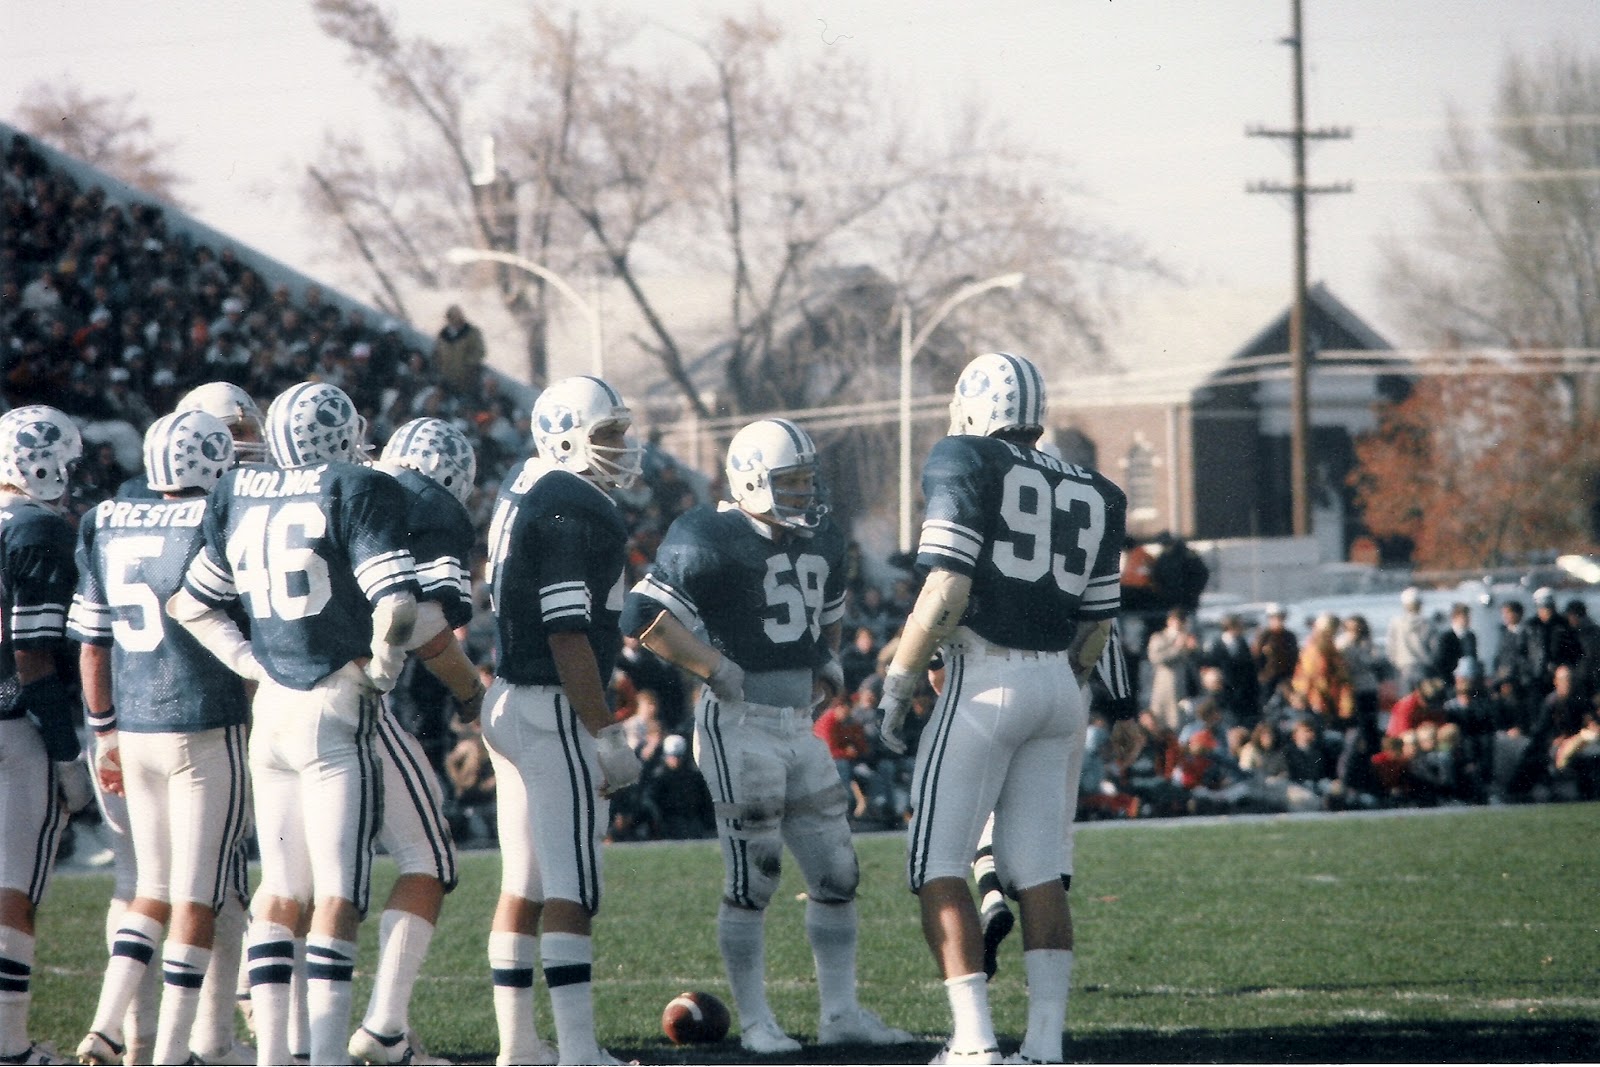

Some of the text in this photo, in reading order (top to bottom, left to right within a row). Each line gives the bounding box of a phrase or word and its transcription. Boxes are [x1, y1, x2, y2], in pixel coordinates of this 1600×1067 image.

[18, 422, 56, 446] Y
[317, 399, 346, 426] Y
[205, 433, 231, 460] Y
[233, 463, 329, 498] HOLMOE
[226, 502, 332, 621] 46
[991, 464, 1106, 597] 93
[105, 535, 164, 652] 5
[763, 553, 830, 644] 59
